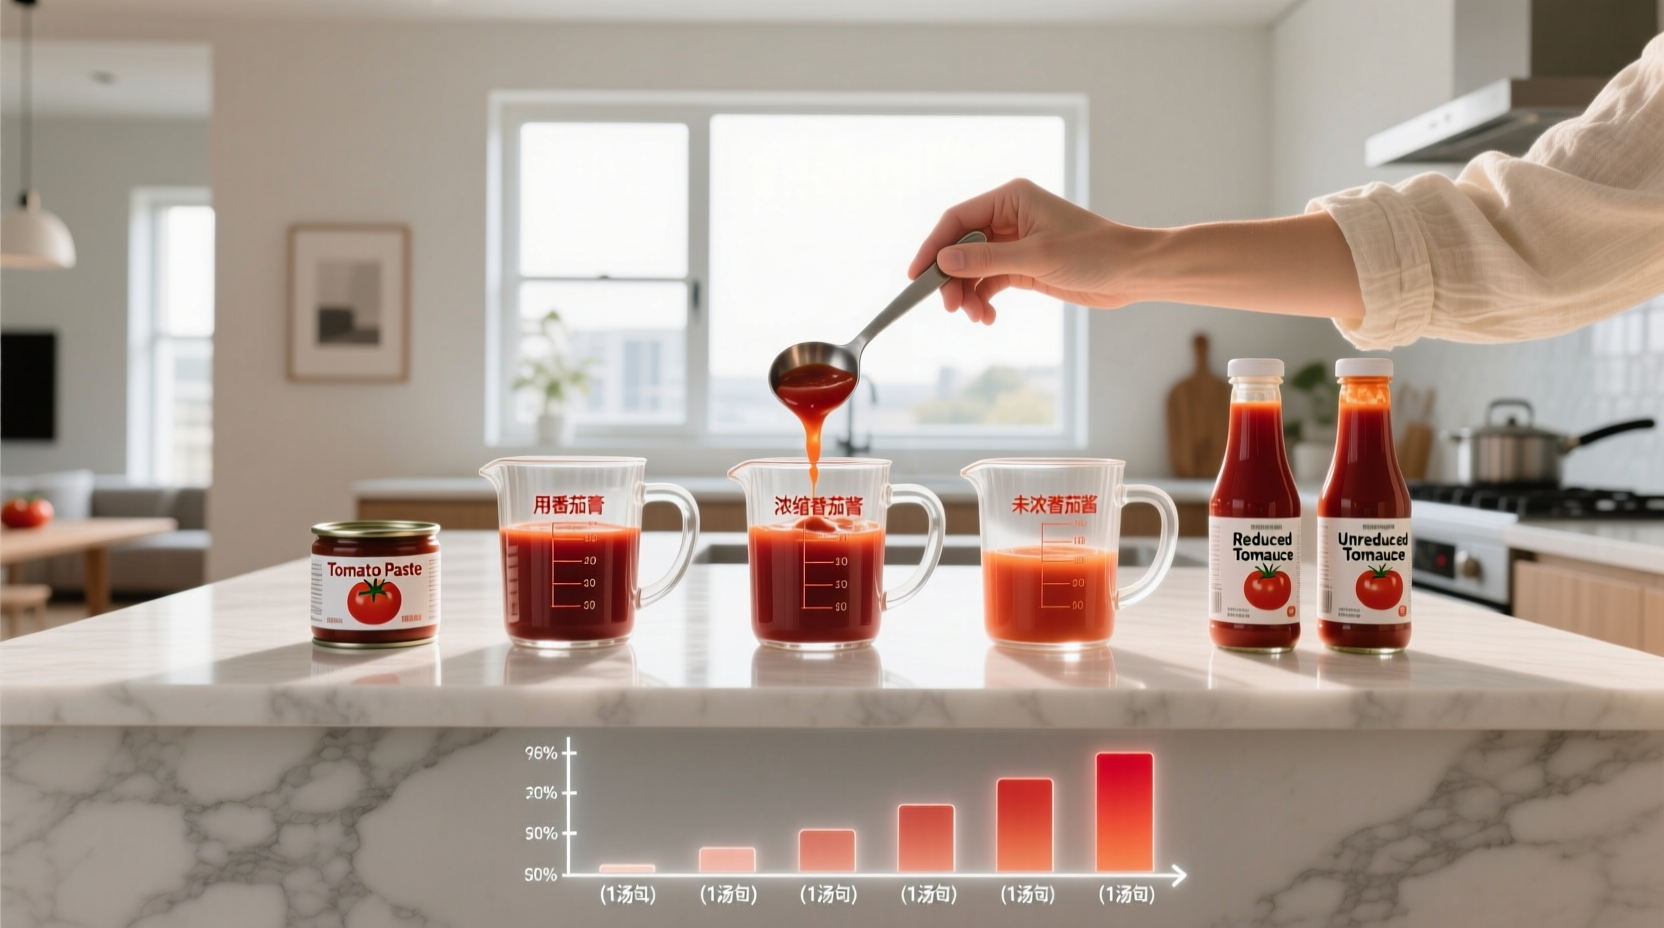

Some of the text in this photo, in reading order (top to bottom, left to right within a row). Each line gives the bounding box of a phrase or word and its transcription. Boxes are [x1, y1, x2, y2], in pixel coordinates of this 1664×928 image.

[1232, 531, 1292, 547] Reduced
[1338, 531, 1409, 547] Unreduced
[1232, 547, 1294, 562] Tomauce
[1342, 547, 1406, 562] Tomauce
[327, 561, 423, 578] Tomato Paste
